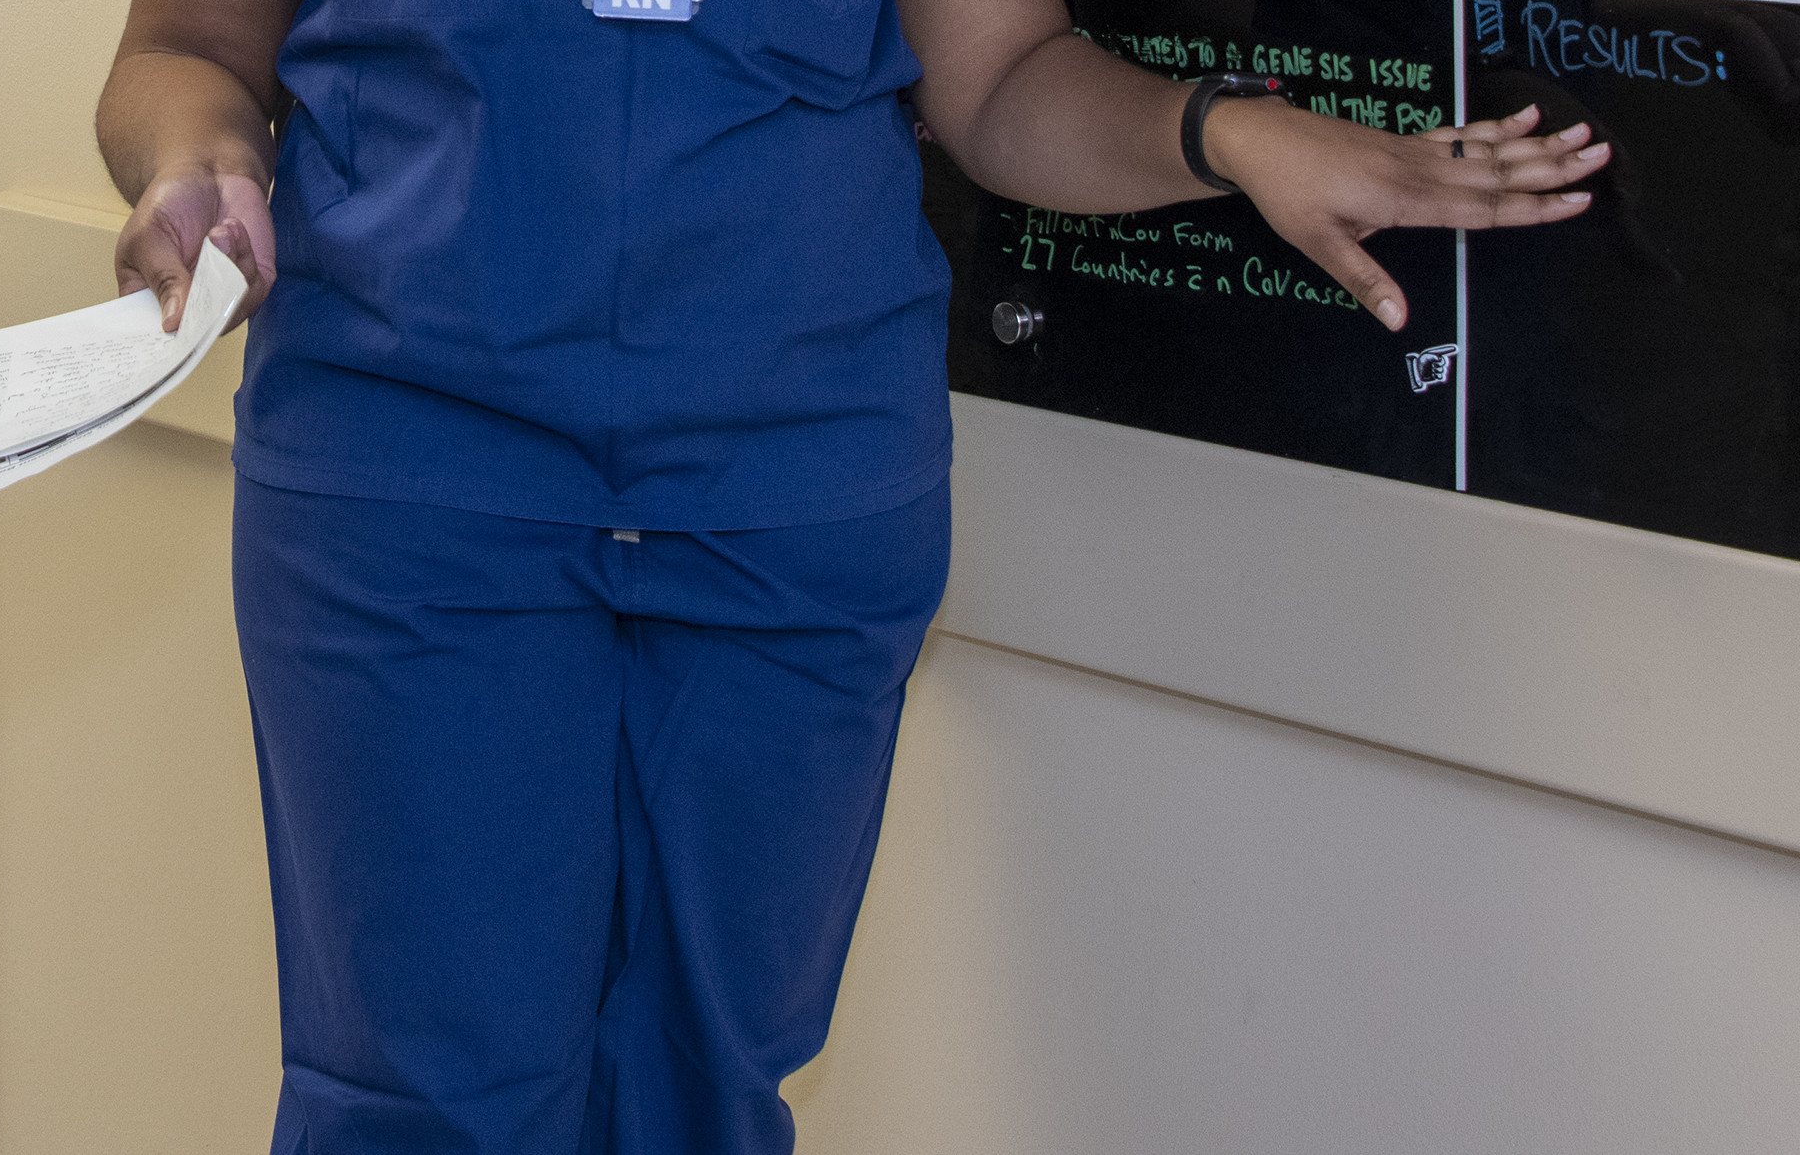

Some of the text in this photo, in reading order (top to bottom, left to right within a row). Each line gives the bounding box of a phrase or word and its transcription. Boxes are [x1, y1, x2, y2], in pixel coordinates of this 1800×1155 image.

[1521, 0, 1727, 87] RESULTS:
[1370, 58, 1433, 91] ISSUE
[1342, 95, 1388, 129] THE
[1173, 221, 1234, 252] Form
[1020, 234, 1056, 270] 27
[1071, 245, 1175, 288] Countries
